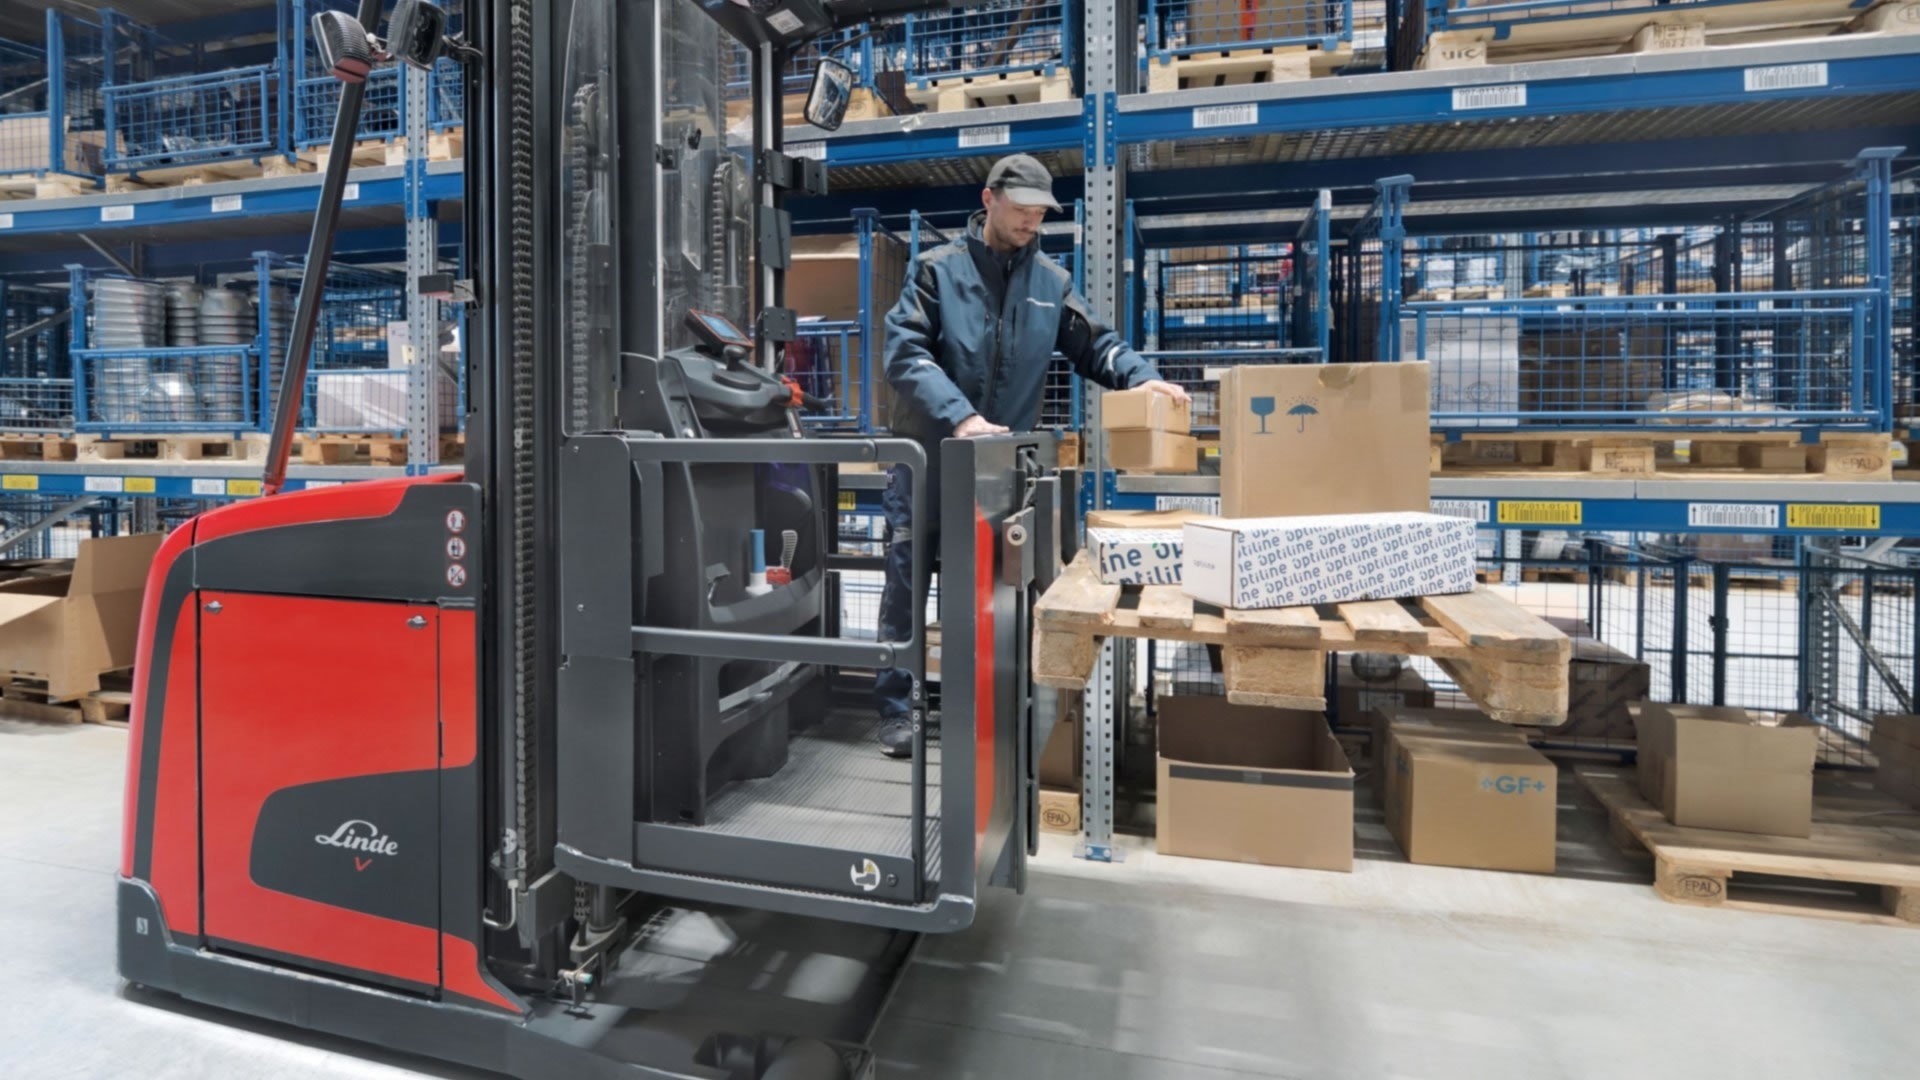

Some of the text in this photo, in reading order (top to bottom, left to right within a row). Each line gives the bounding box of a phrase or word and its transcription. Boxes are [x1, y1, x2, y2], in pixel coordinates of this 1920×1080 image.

[1700, 505, 1767, 513] 007-010-02-1
[1257, 540, 1313, 566] optiline
[1265, 567, 1320, 594] optiline
[1325, 546, 1378, 573] optiline
[1382, 527, 1433, 552] optiline
[1292, 543, 1346, 570] optiline
[1351, 523, 1402, 549] optiline
[1299, 570, 1353, 597] optiline
[1357, 550, 1409, 575] optiline
[1413, 530, 1461, 555] optiline
[1332, 573, 1384, 599] optiline
[1388, 553, 1438, 578] optiline
[1419, 556, 1467, 581] optiline
[315, 819, 398, 856] Linde
